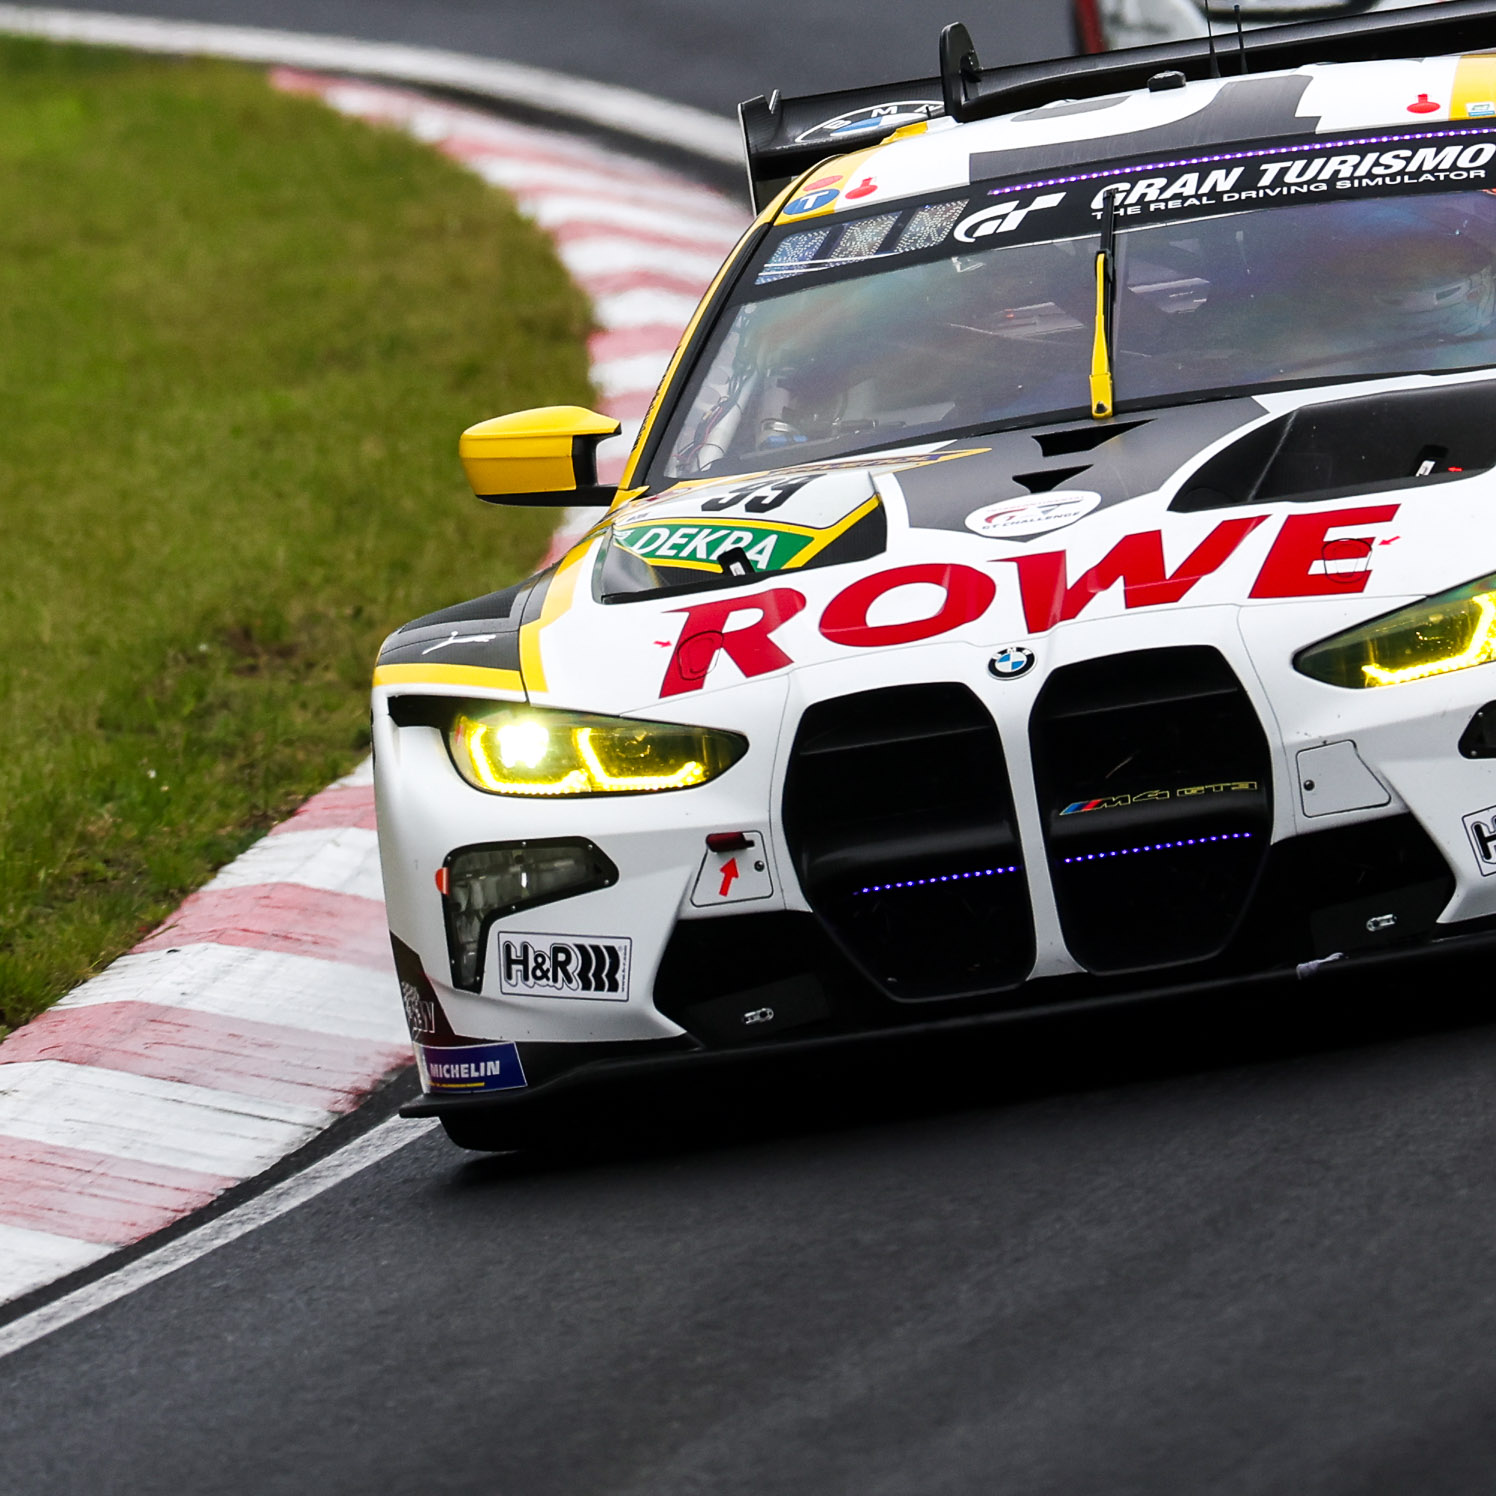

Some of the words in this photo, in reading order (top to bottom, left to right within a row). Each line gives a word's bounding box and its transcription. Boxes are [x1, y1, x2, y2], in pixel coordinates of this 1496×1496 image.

[1092, 167, 1245, 210] GRAN
[1092, 208, 1141, 220] THE
[1150, 194, 1215, 214] REAL
[1222, 183, 1328, 204] DRIVING
[1336, 169, 1486, 189] SIMULATOR
[659, 504, 1402, 699] ROWE
[504, 941, 580, 991] H&R
[429, 1060, 500, 1079] MICHELIN
